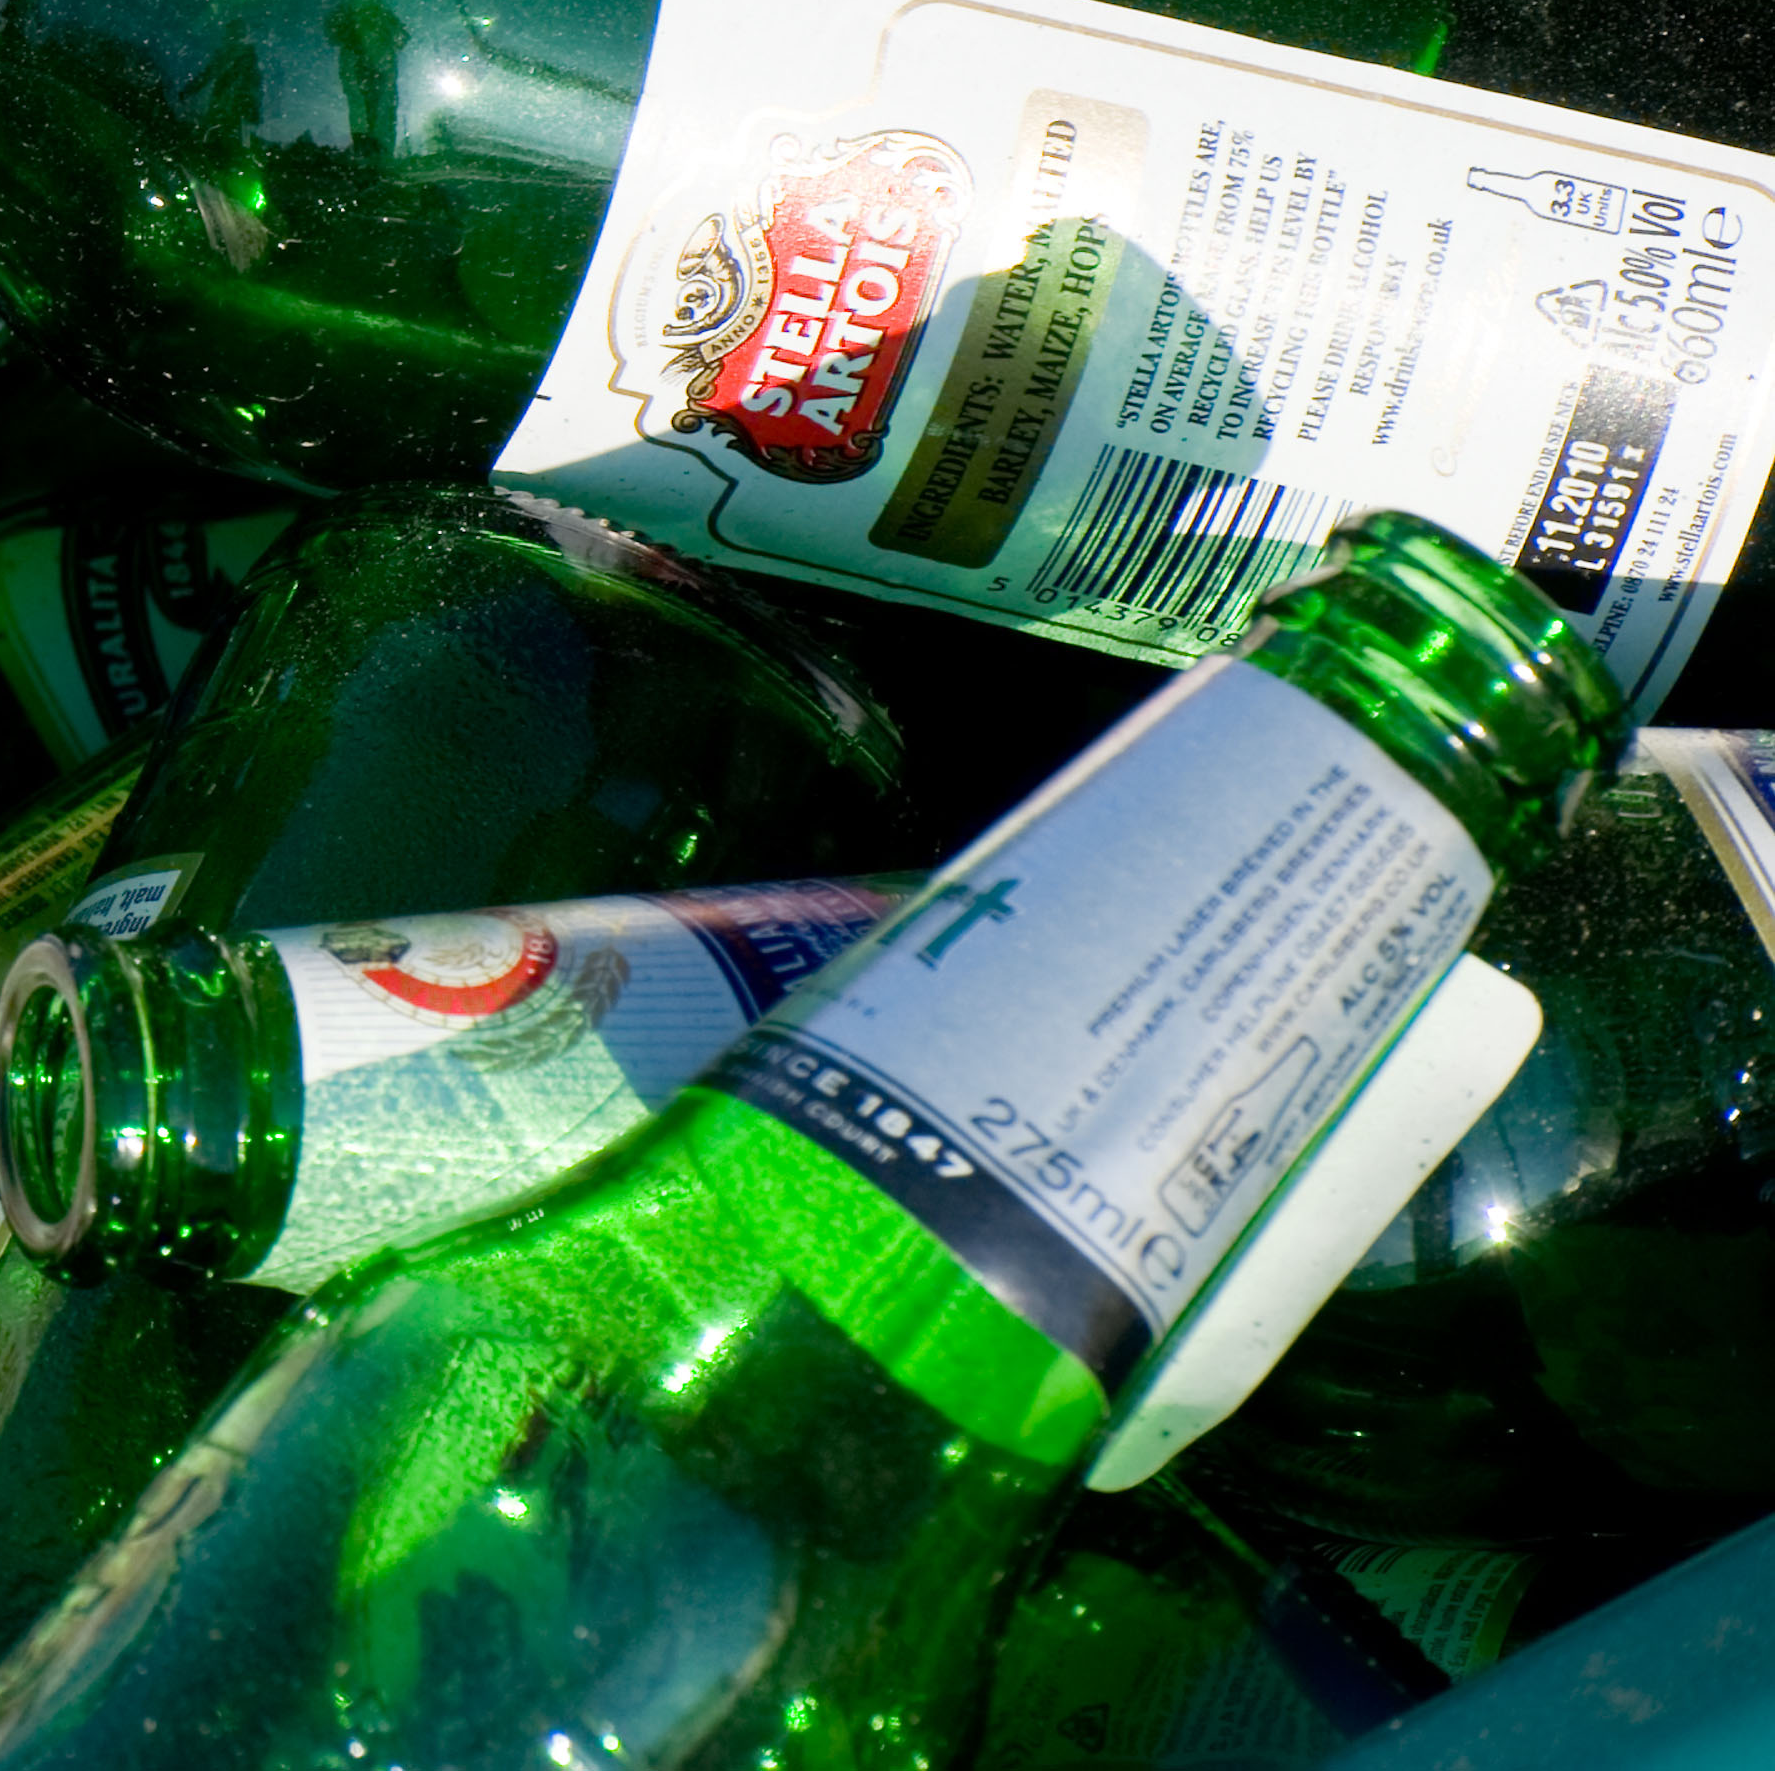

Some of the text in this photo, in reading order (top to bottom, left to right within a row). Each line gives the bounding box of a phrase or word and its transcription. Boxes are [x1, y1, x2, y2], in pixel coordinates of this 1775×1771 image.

[1549, 177, 1576, 217] 3.3
[1576, 190, 1593, 216] UK
[1591, 183, 1612, 230] Units
[739, 193, 858, 419] STELLA
[1613, 187, 1688, 319] 5.0% Vol
[709, 313, 757, 354] ANNO
[795, 202, 918, 439] ARTOIS
[1144, 269, 1178, 353] ARTOIS
[899, 375, 1004, 544] INGREDIENTS:
[982, 246, 1055, 365] WATER,
[976, 288, 1087, 507] BARLEY, MAIZE,
[1149, 401, 1175, 435] ON
[1185, 319, 1237, 429] RECYCLED
[1250, 322, 1304, 443] RECYCLING
[1296, 362, 1331, 443] PLEASE
[1656, 431, 1739, 604] www.stellaartois.com
[986, 574, 1180, 633] 5 014379
[1087, 762, 1350, 1039] PREMIUM LAGER BREWED THE
[1178, 886, 1275, 992] CARLSBERG
[1337, 965, 1378, 1017] ALC
[969, 1095, 1145, 1250] 275ml
